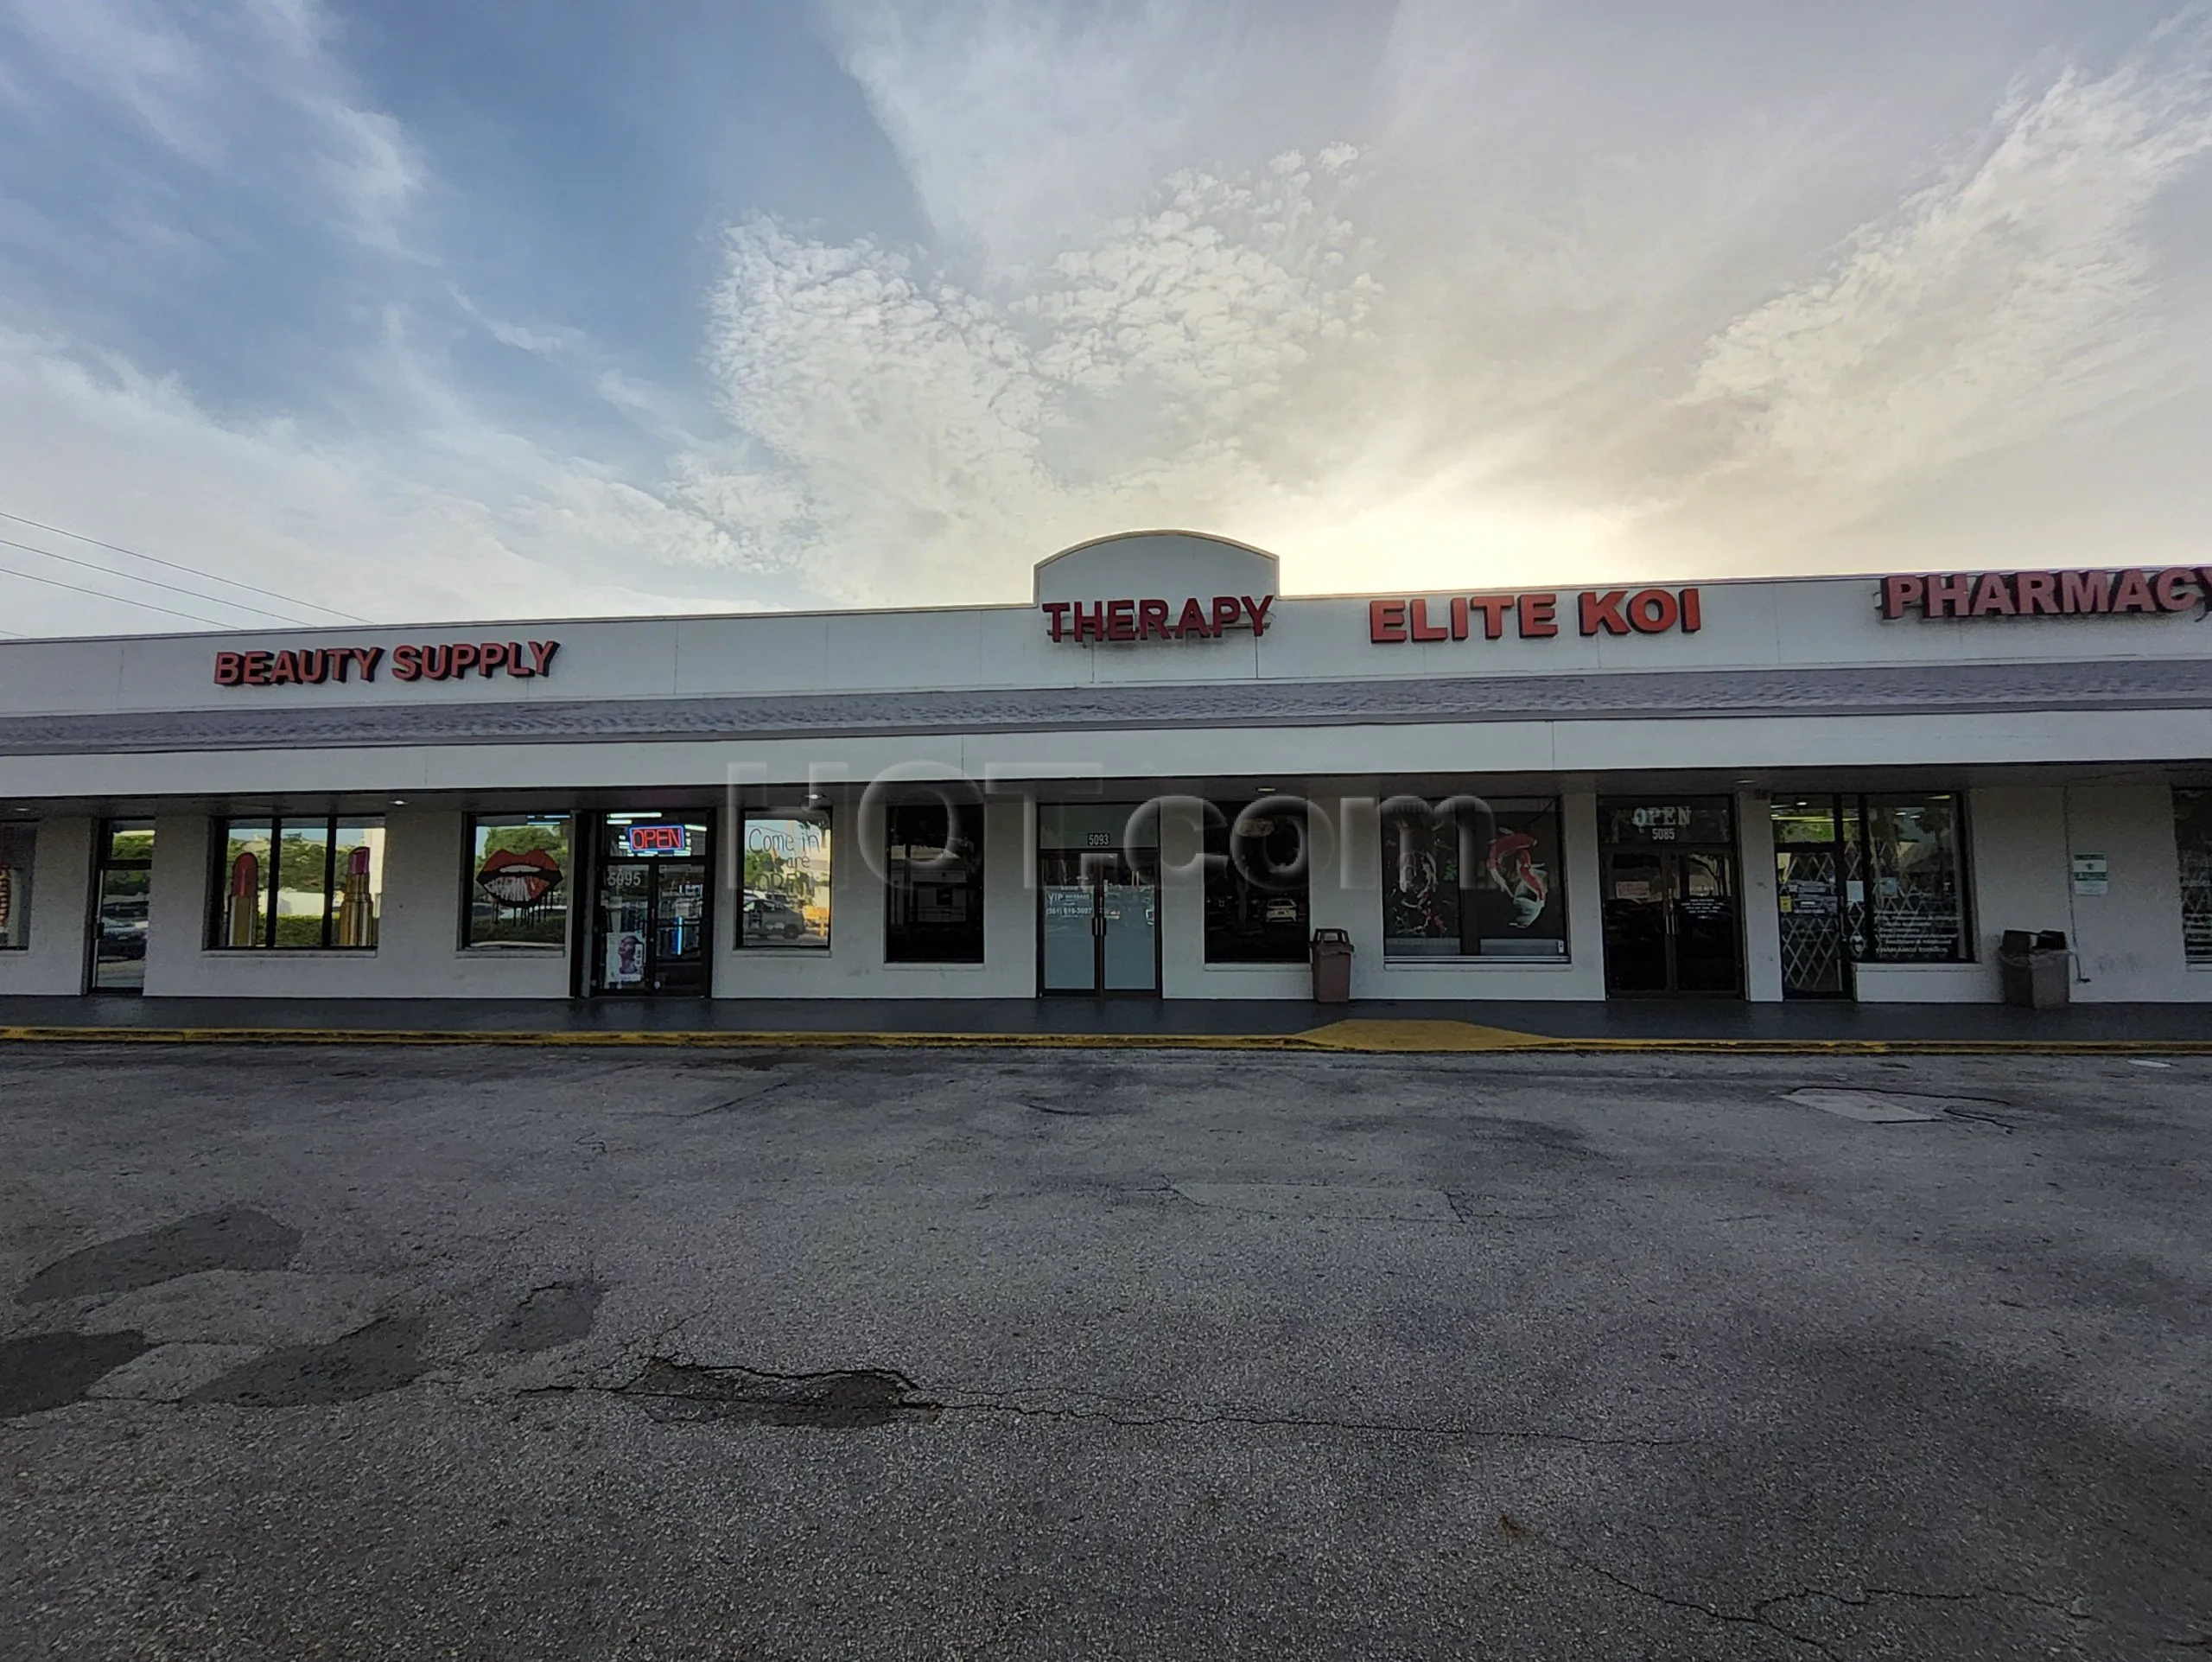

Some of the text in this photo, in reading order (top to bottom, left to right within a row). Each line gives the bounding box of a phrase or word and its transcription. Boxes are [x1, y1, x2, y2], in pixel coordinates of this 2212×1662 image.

[1042, 595, 1274, 643] THERAPY
[1370, 589, 1701, 643] ELITE KOI
[214, 640, 561, 685] BEAUTY SUPPLY
[1632, 806, 1692, 826] OPEN
[632, 829, 682, 849] OPEN
[749, 828, 820, 853] Come in
[1089, 834, 1109, 845] 5093
[1652, 828, 1675, 840] 5085
[786, 855, 810, 869] are
[607, 872, 641, 887] 5095
